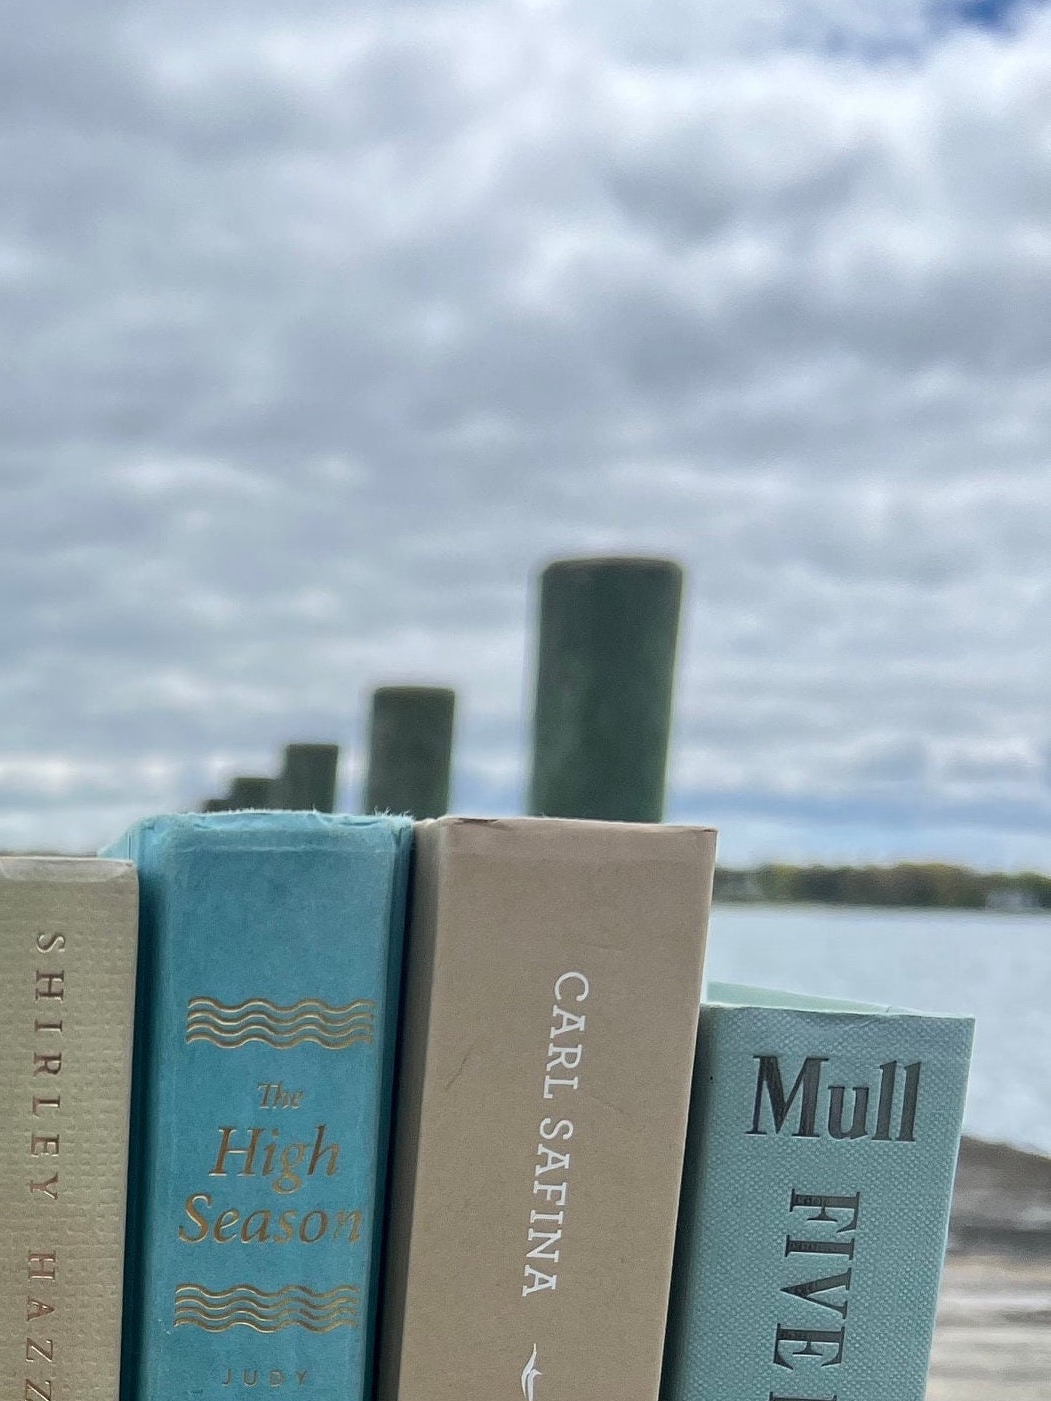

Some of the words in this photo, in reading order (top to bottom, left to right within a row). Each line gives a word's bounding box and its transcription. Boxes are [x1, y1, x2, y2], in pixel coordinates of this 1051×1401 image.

[30, 932, 66, 1201] SHIRLEY
[541, 970, 590, 1100] CARL
[258, 1082, 304, 1109] The
[745, 1055, 922, 1143] Mull
[209, 1124, 341, 1194] High
[179, 1192, 362, 1244] Season
[521, 1118, 574, 1298] SAFINA
[771, 1187, 860, 1372] FIVE
[221, 1369, 308, 1387] JUDY
